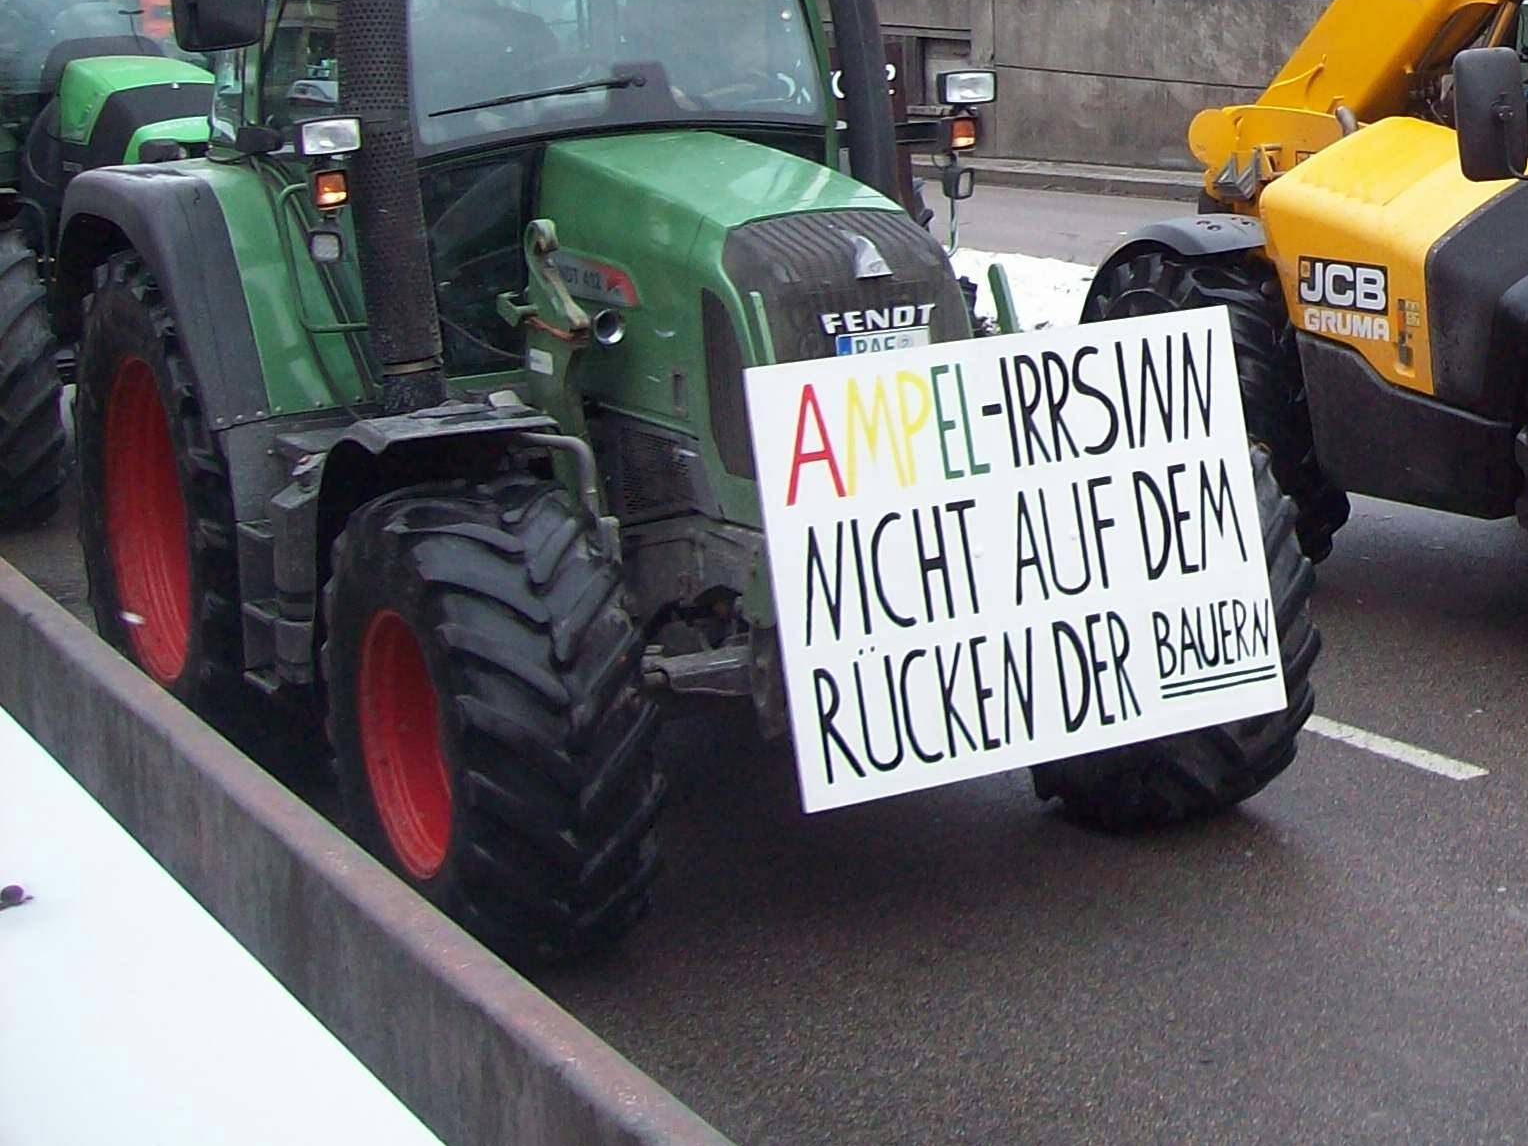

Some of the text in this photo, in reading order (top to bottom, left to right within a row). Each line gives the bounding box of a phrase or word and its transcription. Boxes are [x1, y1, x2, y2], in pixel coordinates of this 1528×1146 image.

[820, 304, 936, 334] FENDT
[1300, 262, 1386, 311] JCB
[1304, 308, 1390, 342] GRUMA
[786, 329, 1212, 506] AMPEL-IRRSINN
[805, 458, 1247, 646] NICHT AUF DEM
[813, 598, 1270, 785] RÜCKEN DER BAUERN
